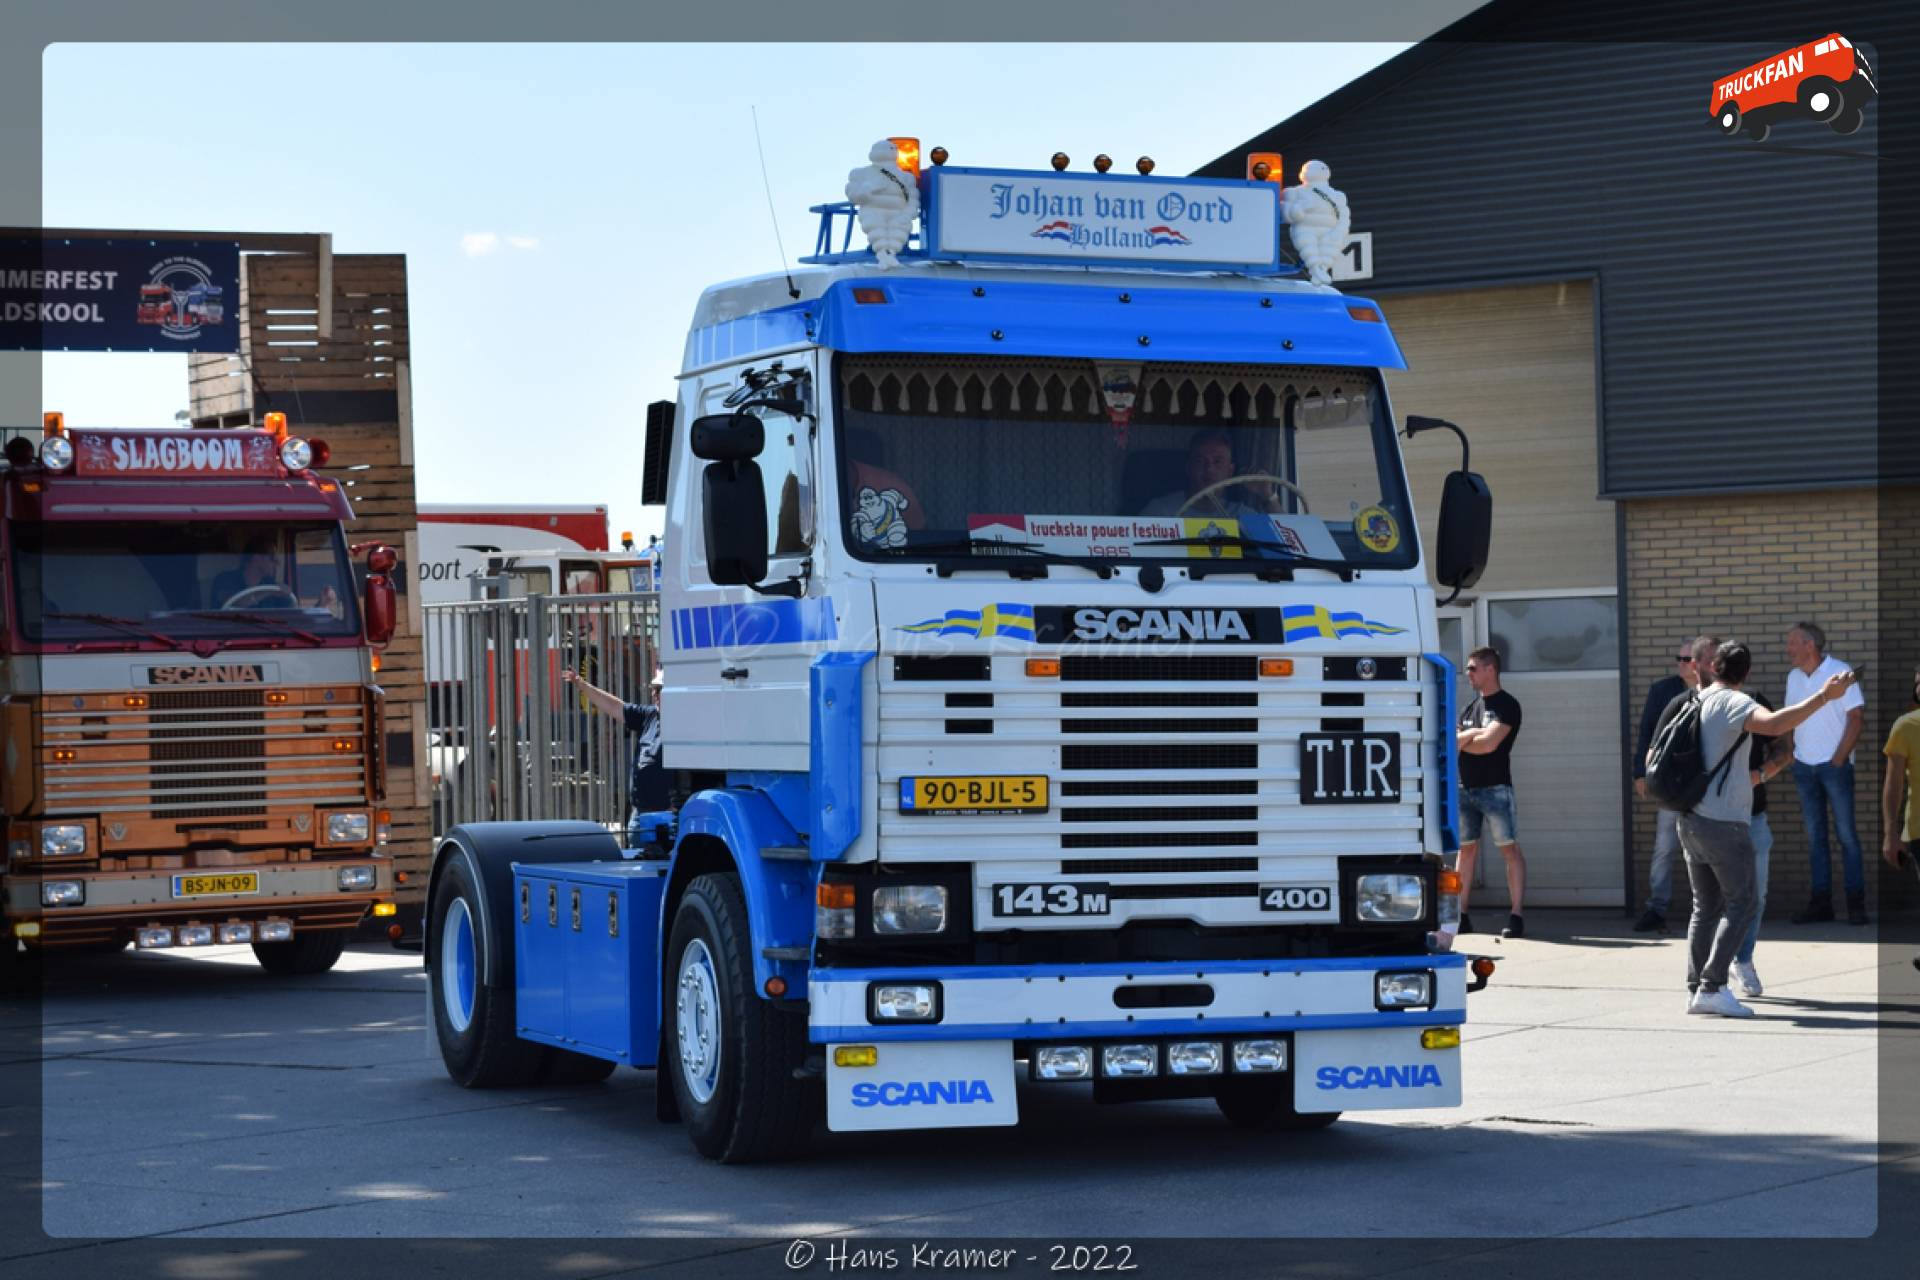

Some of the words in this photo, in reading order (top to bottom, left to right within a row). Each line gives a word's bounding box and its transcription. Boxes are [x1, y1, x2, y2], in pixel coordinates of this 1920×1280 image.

[989, 183, 1083, 222] Johan
[1094, 191, 1145, 220] van
[1156, 192, 1233, 223] Oord
[1069, 222, 1156, 250] Holland
[1342, 241, 1362, 272] 1
[0, 303, 104, 322] DSKOOL
[111, 436, 244, 471] SLAGBOOM
[1030, 521, 1088, 537] truckstar
[1091, 525, 1129, 541] power
[1132, 522, 1180, 539] festival
[1087, 545, 1131, 558] 1985
[418, 558, 461, 583] port
[1073, 608, 1250, 640] SCANIA
[153, 665, 259, 684] SCANIA
[924, 781, 1036, 804] 90-BJL-5
[185, 876, 251, 893] BS-JN-09
[1265, 889, 1327, 908] 400
[1316, 1065, 1442, 1090] SCANIA
[851, 1080, 994, 1107] SCANIA
